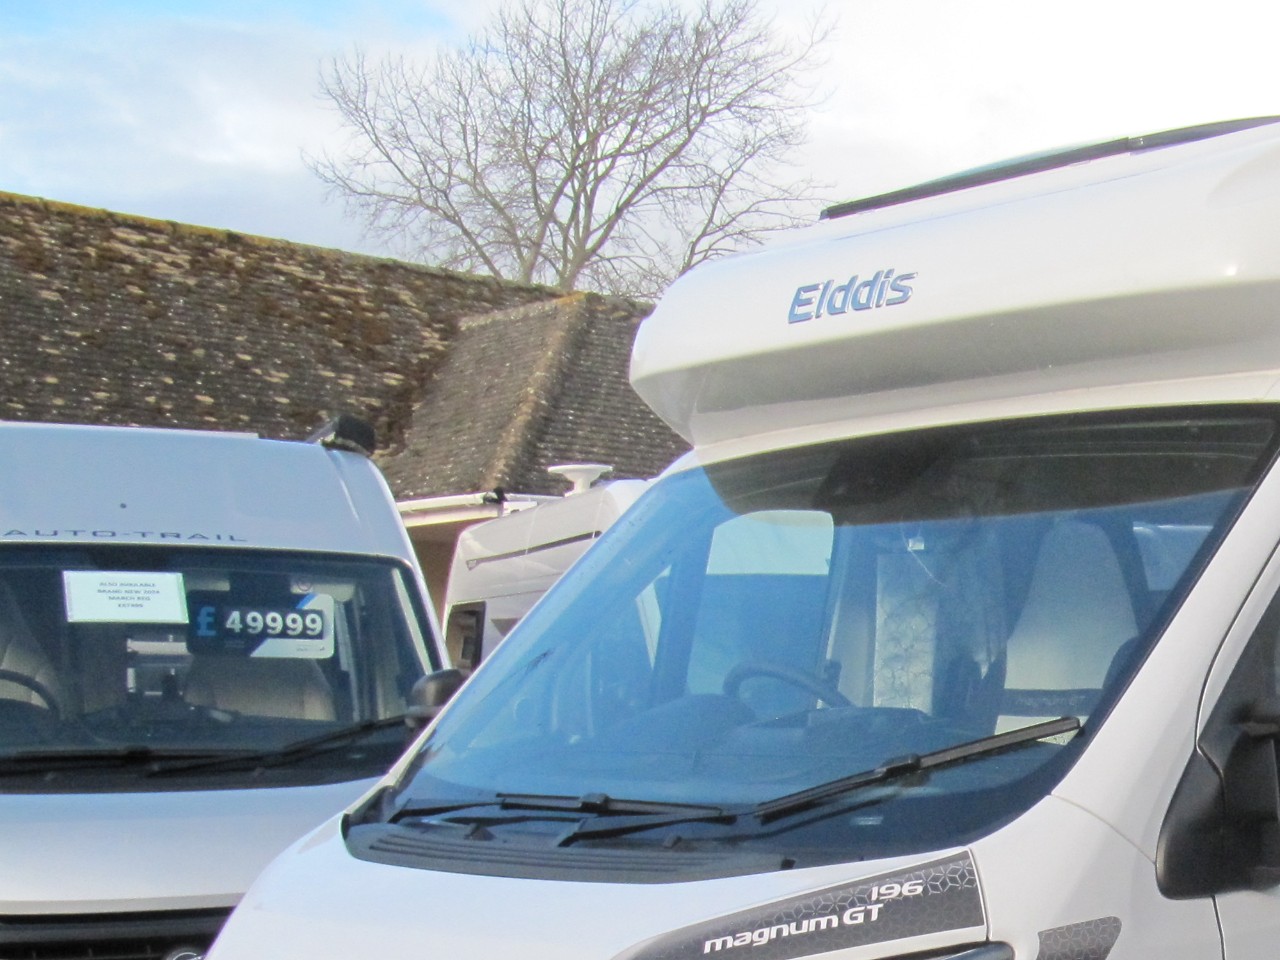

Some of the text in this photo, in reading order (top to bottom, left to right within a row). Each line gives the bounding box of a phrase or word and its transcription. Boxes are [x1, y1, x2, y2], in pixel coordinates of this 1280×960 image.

[788, 268, 918, 324] Elddis
[4, 529, 247, 542] AUTO-TRAIL
[197, 606, 323, 636] £ 49999
[870, 879, 923, 901] 196
[703, 903, 884, 954] magnum GT
